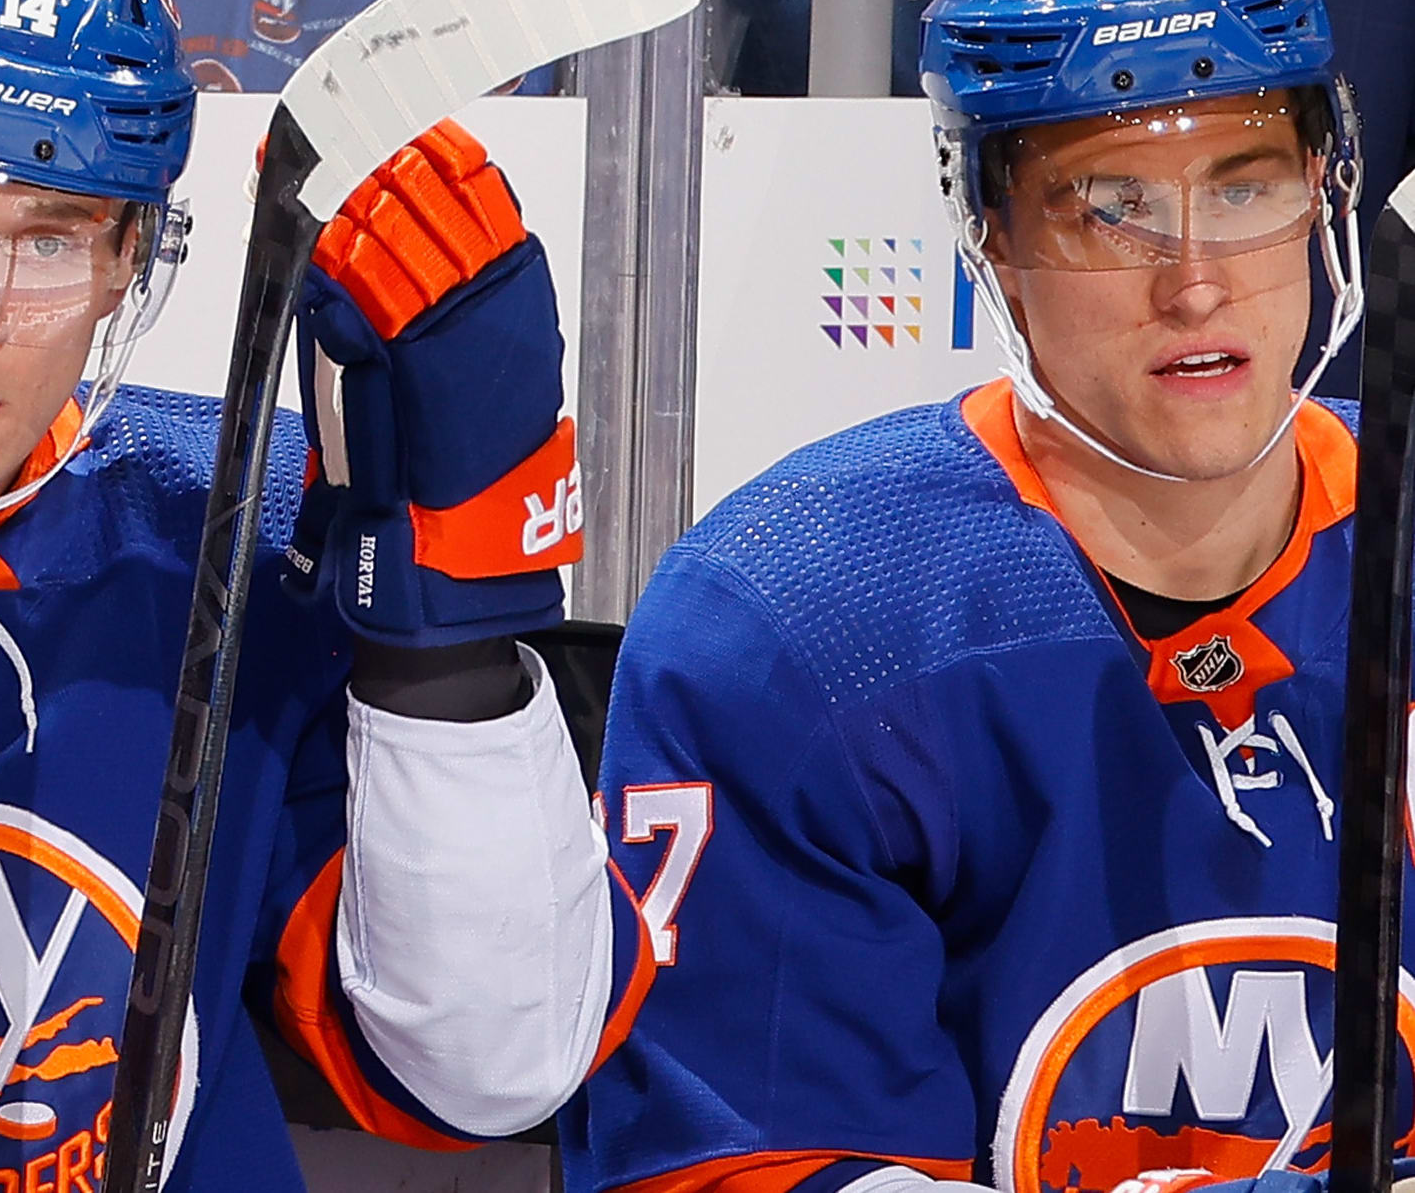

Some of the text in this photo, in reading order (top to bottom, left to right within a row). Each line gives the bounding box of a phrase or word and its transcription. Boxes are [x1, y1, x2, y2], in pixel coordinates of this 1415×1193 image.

[356, 533, 377, 608] HORVAT
[1194, 651, 1225, 685] NHL
[591, 781, 716, 967] 7
